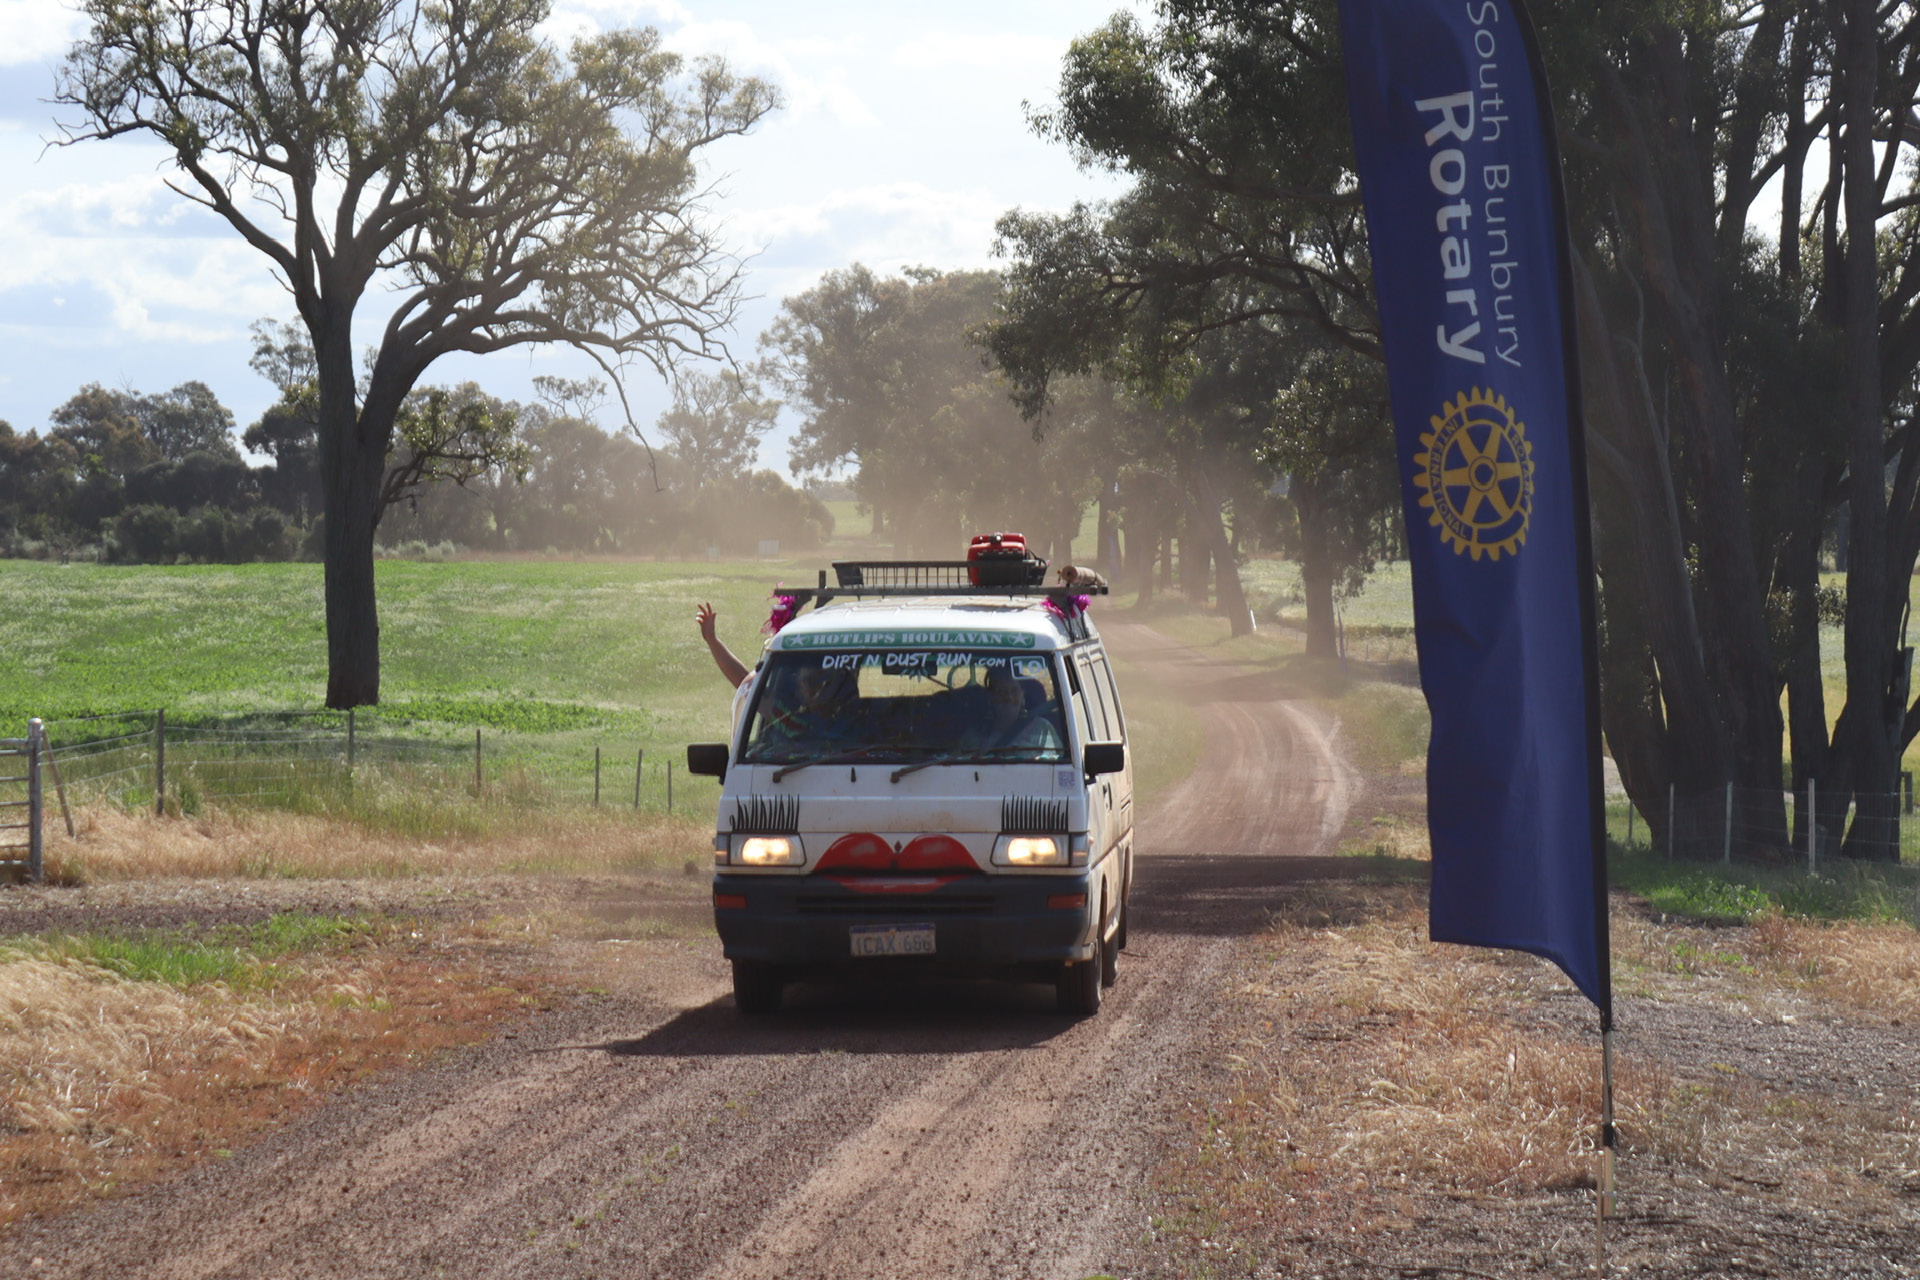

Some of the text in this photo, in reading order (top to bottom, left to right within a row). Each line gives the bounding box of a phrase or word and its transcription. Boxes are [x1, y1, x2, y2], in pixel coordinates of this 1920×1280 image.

[1415, 91, 1485, 364] Rotary
[1467, 1, 1521, 367] South Bunbury
[1431, 418, 1467, 538] INTERNATIONAL
[811, 632, 1002, 645] HOTLIPS HOULAVAN
[822, 654, 862, 670] DIRT
[865, 653, 880, 666] N
[885, 652, 932, 667] DUST
